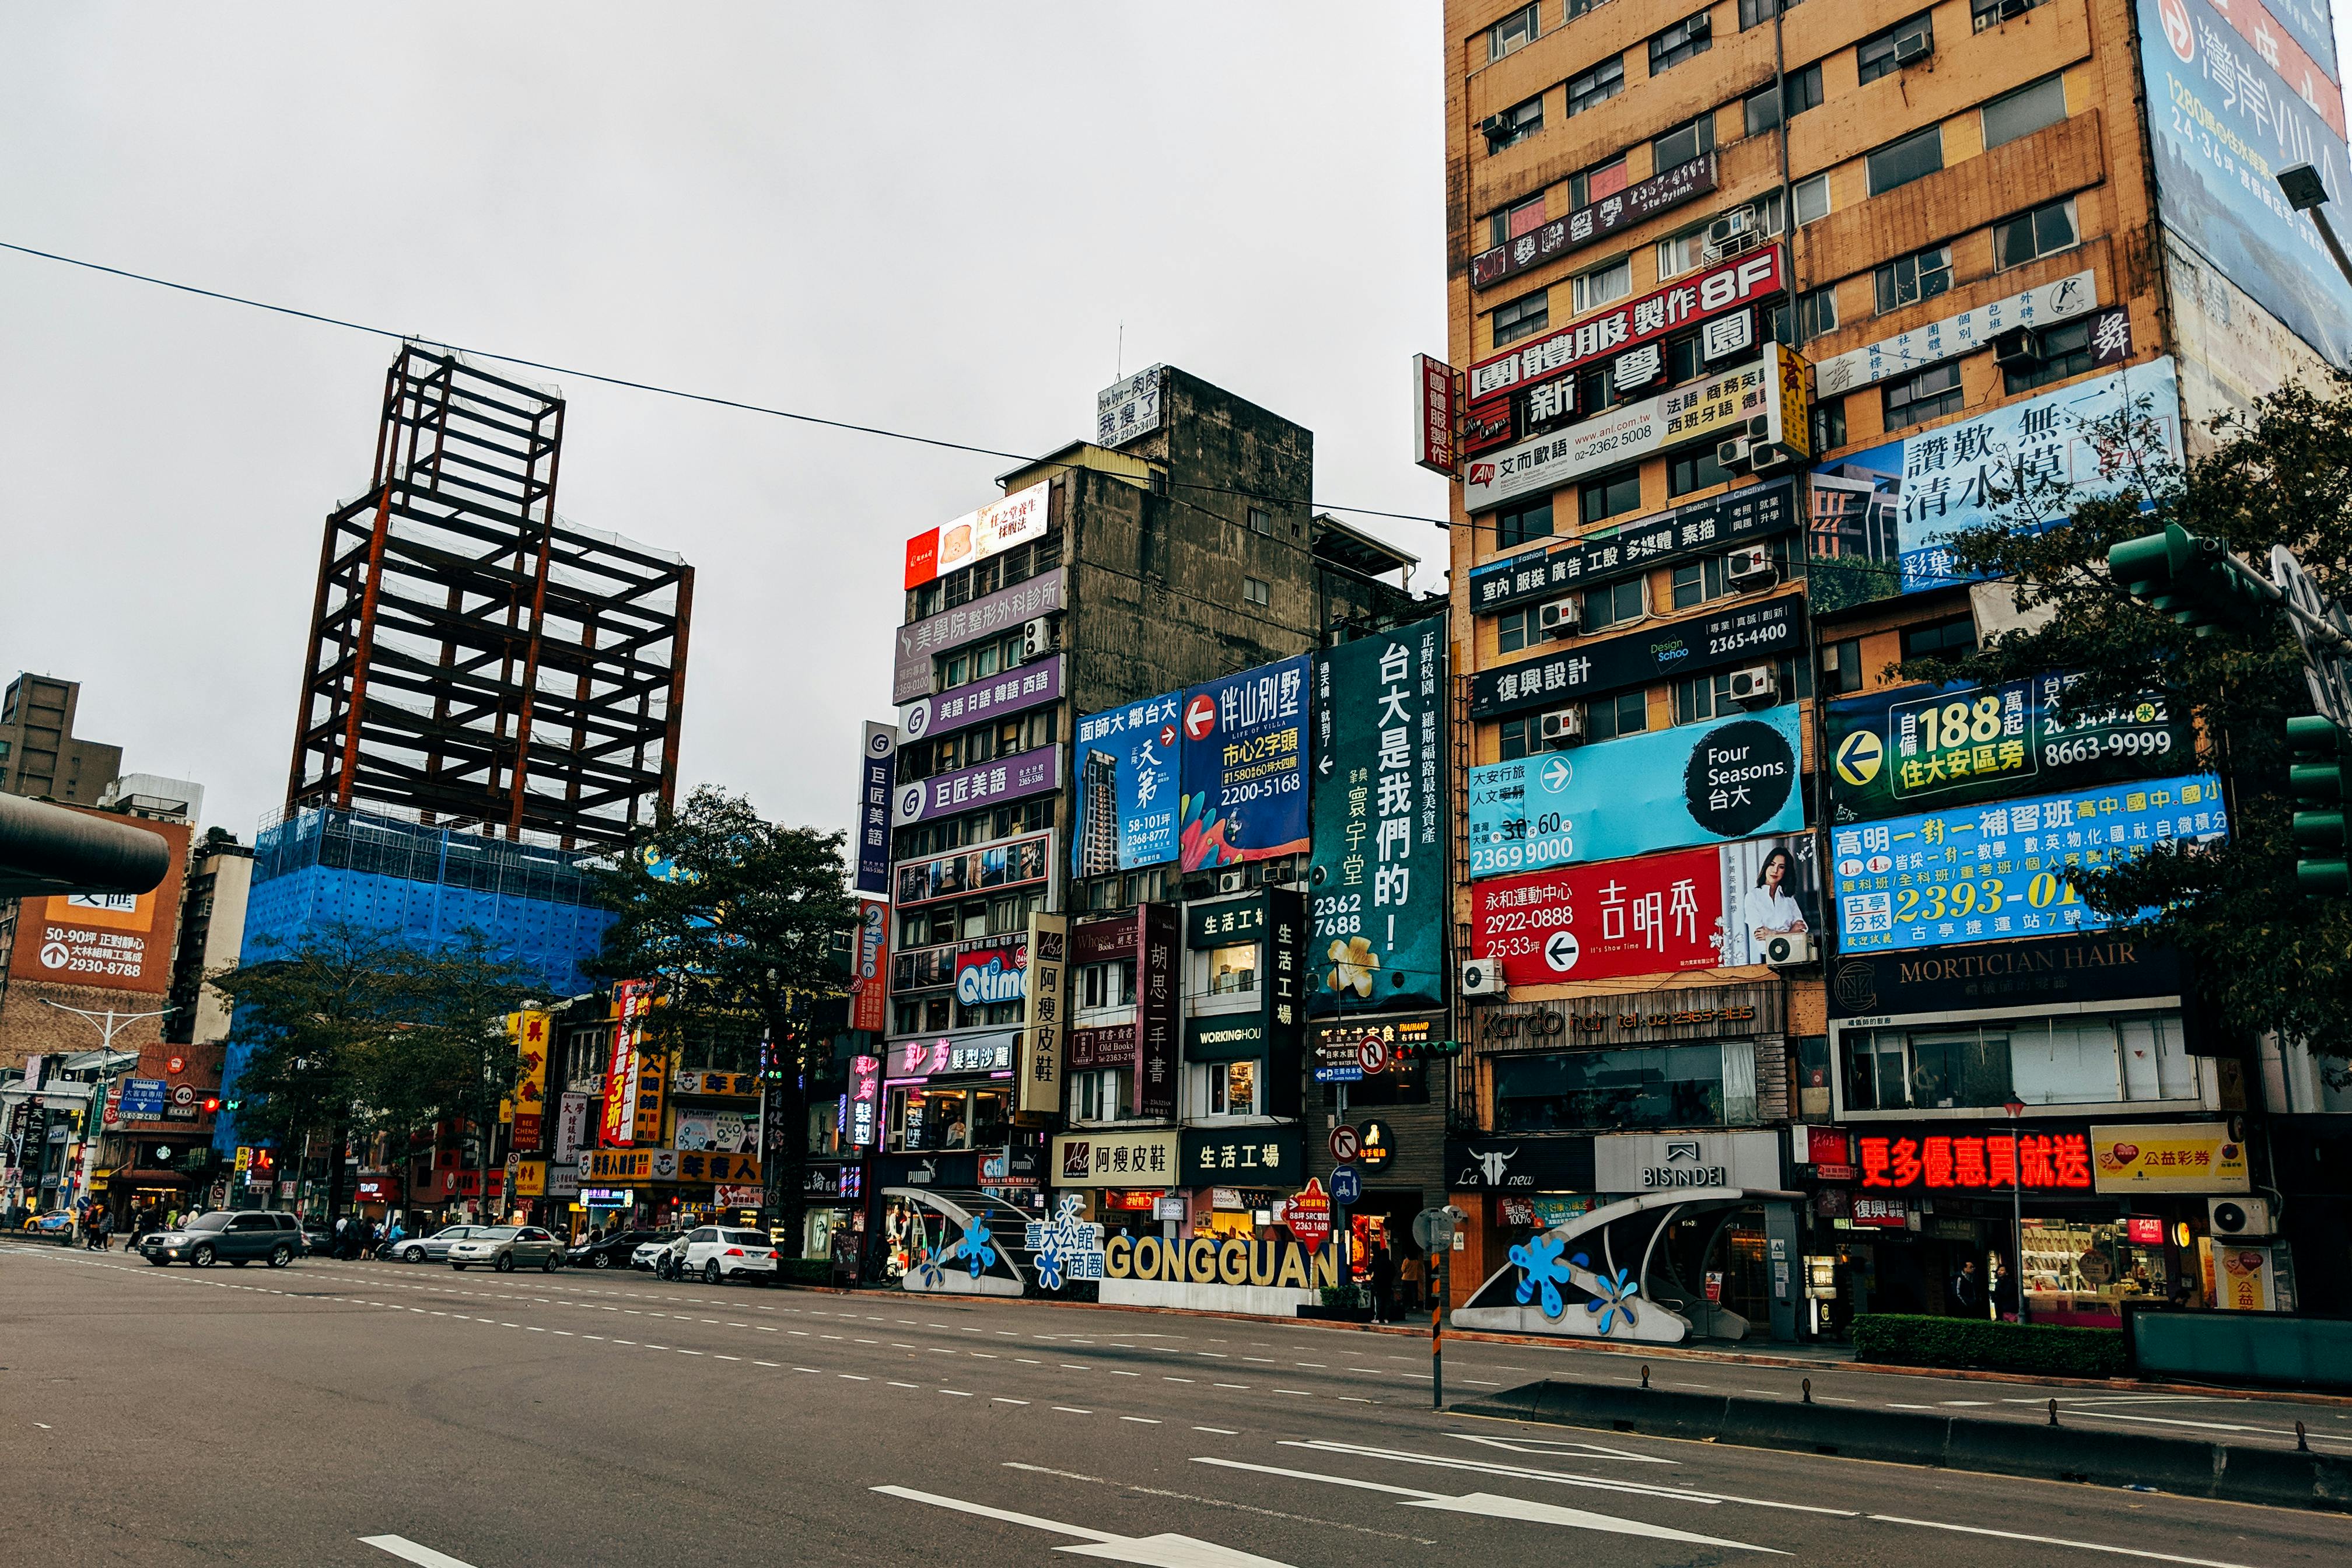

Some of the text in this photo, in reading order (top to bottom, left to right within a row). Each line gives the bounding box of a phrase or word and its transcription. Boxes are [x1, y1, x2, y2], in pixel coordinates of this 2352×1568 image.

[1988, 304, 2003, 330] 包班
[2020, 292, 2035, 319] 外聘
[1928, 323, 1941, 349] 團體
[1957, 314, 1971, 340] 個別
[2092, 313, 2127, 359] 舞
[1897, 335, 1910, 360] 社交
[1426, 358, 1450, 377] 新學園
[1100, 391, 1157, 438] 我瘦了
[1667, 391, 1698, 415] 法語
[1430, 372, 1447, 464] 團體服製作
[1464, 418, 1508, 439] New Campus
[1574, 414, 1651, 445] www.anl.com.tw
[1668, 399, 1734, 435] 西班牙語
[1575, 425, 1651, 461] 02-2362 5008
[1907, 424, 1994, 480] 讚歎
[1500, 438, 1567, 477] 艾而歐語
[1471, 465, 1494, 482] ANL
[1734, 484, 1766, 499] Creative
[1686, 502, 1708, 513] Sketch
[1555, 541, 1575, 552] Visual
[1588, 528, 1615, 541] Product
[1480, 563, 1503, 574] Interior
[1483, 518, 1716, 601] 室內 服裝 廣告 工設 多媒體 素描
[1518, 550, 1544, 563] Fashion
[1710, 607, 1784, 634] 專業 真誠 創新
[1650, 639, 1684, 654] Design
[1710, 623, 1787, 655] 2365-4400
[895, 675, 929, 697] 2369-0100
[1497, 656, 1591, 702] 復興設計
[940, 670, 1049, 721] 美語 日語 韓語 西語
[1219, 668, 1301, 733] 伴山別墅
[1080, 698, 1177, 743] 面師大 鄰台大
[1917, 696, 2001, 750] 188
[2002, 689, 2023, 737] 萬起
[1232, 730, 1248, 740] LIFE
[1264, 720, 1286, 730] VILLA
[1899, 714, 1917, 759] 自備
[1223, 727, 1298, 767] 市心2字頭
[1708, 745, 1749, 766] Four
[2045, 731, 2171, 766] 8663-9999
[1473, 765, 1525, 786] 大安行旅
[1899, 739, 2025, 790] 住大安區旁
[935, 766, 1006, 808] 巨匠美語
[1019, 774, 1044, 788] 2365-5366
[1221, 773, 1300, 806] 2200-5168
[867, 766, 886, 846] 巨匠美語
[1473, 784, 1525, 806] 人文寧靜
[1709, 785, 1752, 811] 台大
[1128, 813, 1171, 833] 58-101坪
[1342, 785, 1368, 886] 寰宇堂
[1538, 812, 1560, 834] 60
[1127, 828, 1170, 847] 2368-8777
[1314, 893, 1362, 917] 2362
[1486, 881, 1573, 911] 永和運動中心
[1847, 895, 1886, 912] 古亭
[1315, 914, 1361, 937] 7688
[1486, 905, 1573, 934] 2922-0888
[1598, 878, 1699, 953] 吉明秀
[1850, 914, 1887, 931] 分校
[44, 927, 145, 951] 50-90坪 正對靜心
[1077, 933, 1115, 952] Whose Books
[71, 944, 143, 963] 大林組精工落成
[1900, 942, 2138, 984] MORTICIAN HAIR
[68, 957, 141, 978] 2930-8788
[1278, 923, 1292, 1025] 生活工場
[1035, 967, 1058, 1082] 阿瘦皮鞋
[1149, 943, 1167, 1083] 胡思二手書
[1482, 1007, 1562, 1038] Kardo
[1647, 1013, 1668, 1026] 02
[1399, 1022, 1429, 1032] THAIHAND
[951, 1046, 1009, 1070] 髮型沙龍
[1099, 1040, 1133, 1052] Old Books
[125, 1090, 163, 1100] 大客車專用
[177, 1091, 191, 1101] 40
[26, 1108, 44, 1156] 天仁茗茶
[854, 1102, 873, 1145] 髮型
[1012, 1161, 1031, 1170] PUMA
[1095, 1144, 1166, 1173] 阿瘦皮鞋
[1200, 1143, 1279, 1168] 生活工場
[1360, 1148, 1386, 1158] 右手餐廳
[1860, 1133, 2091, 1188] 更多優惠買就送
[2144, 1150, 2210, 1166] 公益彩券
[908, 1171, 932, 1183] PUMA
[1457, 1167, 1535, 1187] La new
[1508, 1213, 1531, 1225] 100%
[1854, 1200, 1887, 1218] 復興
[1026, 1222, 1095, 1252] 臺大公館
[1069, 1252, 1104, 1279] 商圈
[1107, 1235, 1338, 1288] GONGGUAN
